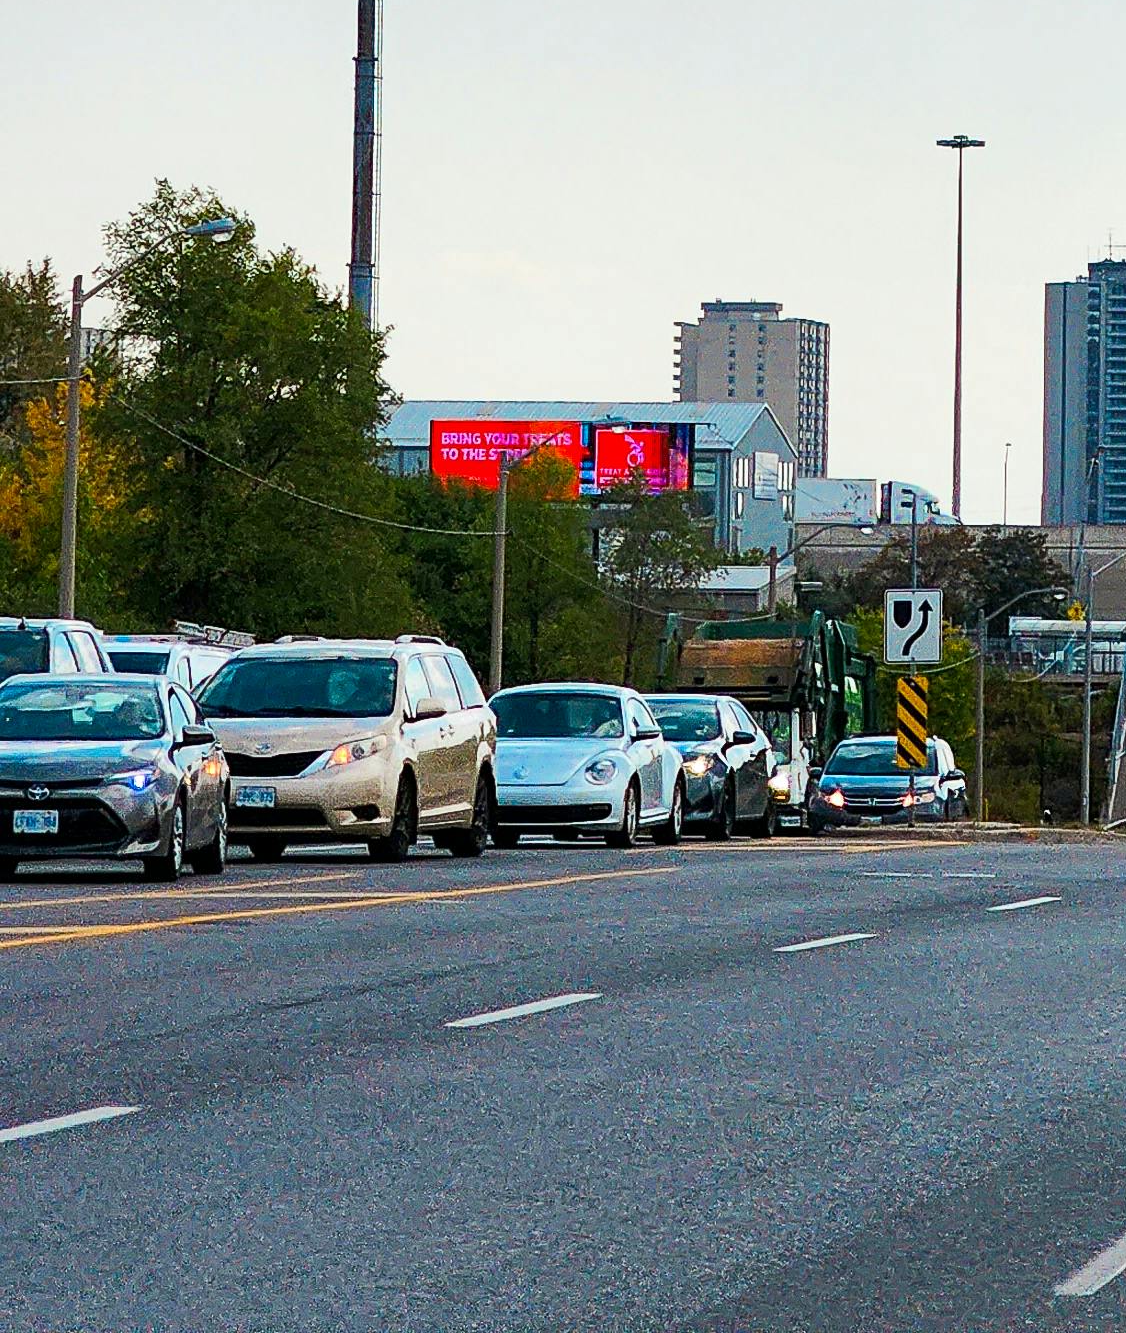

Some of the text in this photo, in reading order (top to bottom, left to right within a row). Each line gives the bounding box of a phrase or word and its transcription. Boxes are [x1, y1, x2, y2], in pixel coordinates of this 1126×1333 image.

[441, 432, 572, 446] BRING YOUR TREATS
[441, 448, 459, 460] TO
[461, 448, 487, 460] THE
